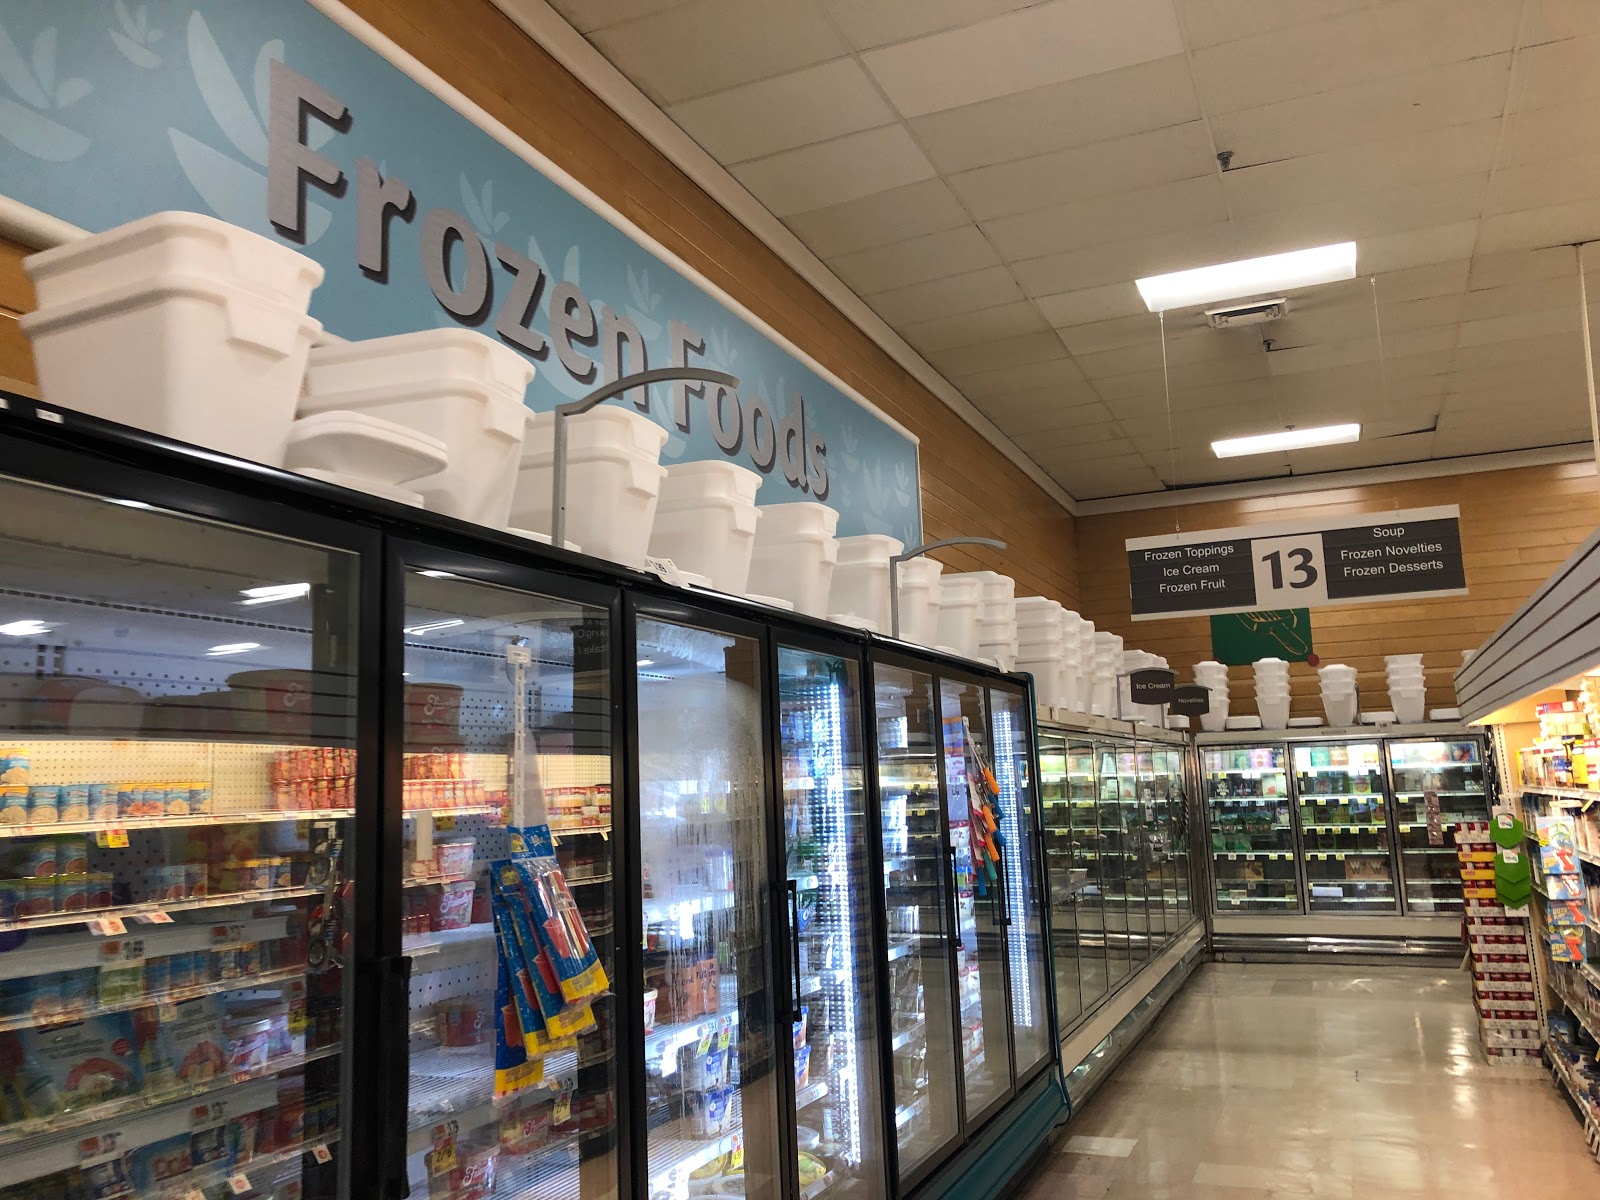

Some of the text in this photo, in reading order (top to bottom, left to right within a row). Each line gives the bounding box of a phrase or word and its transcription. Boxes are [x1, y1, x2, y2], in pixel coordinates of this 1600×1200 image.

[266, 57, 829, 501] Frozen Foods
[1373, 527, 1405, 538] Soup
[1144, 545, 1234, 561] Frozen Toppings
[1340, 542, 1443, 560] Frozen Novelties
[1163, 564, 1220, 577] Ice Cream
[1261, 547, 1319, 590] 13
[1343, 560, 1444, 577] Frozen Desserts
[1159, 578, 1226, 593] Frozen Fruit
